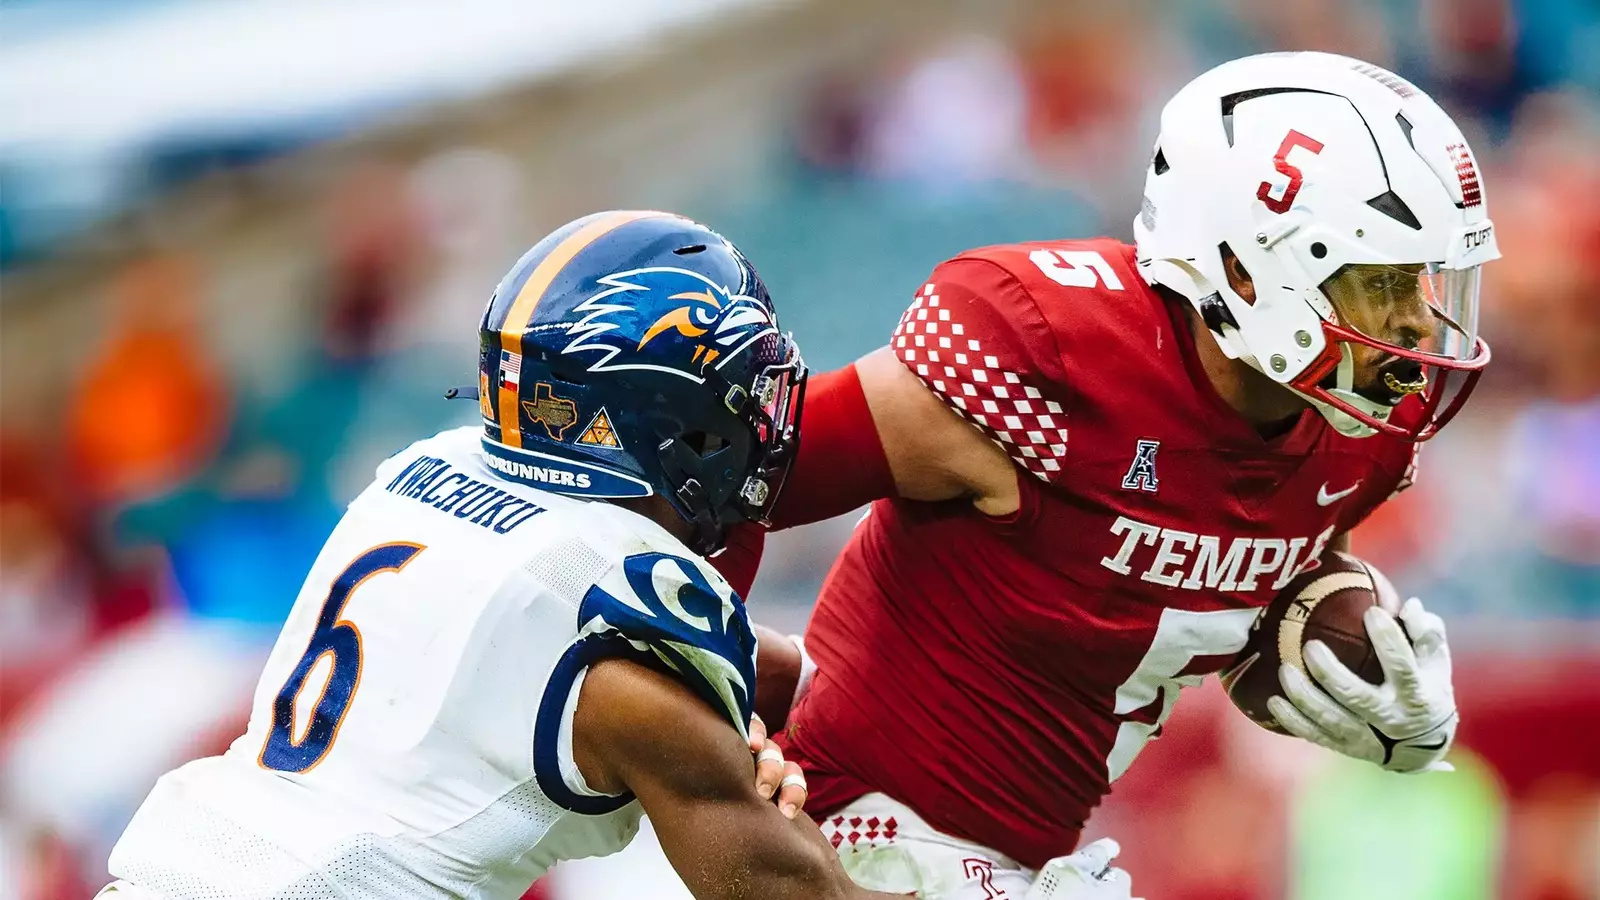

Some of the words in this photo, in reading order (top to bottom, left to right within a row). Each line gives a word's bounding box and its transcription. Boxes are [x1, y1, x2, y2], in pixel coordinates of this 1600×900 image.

[1256, 128, 1325, 215] 5
[1029, 249, 1125, 291] 5
[386, 455, 547, 534] NWACHUKU
[257, 541, 428, 775] 6
[1106, 606, 1264, 784] 5
